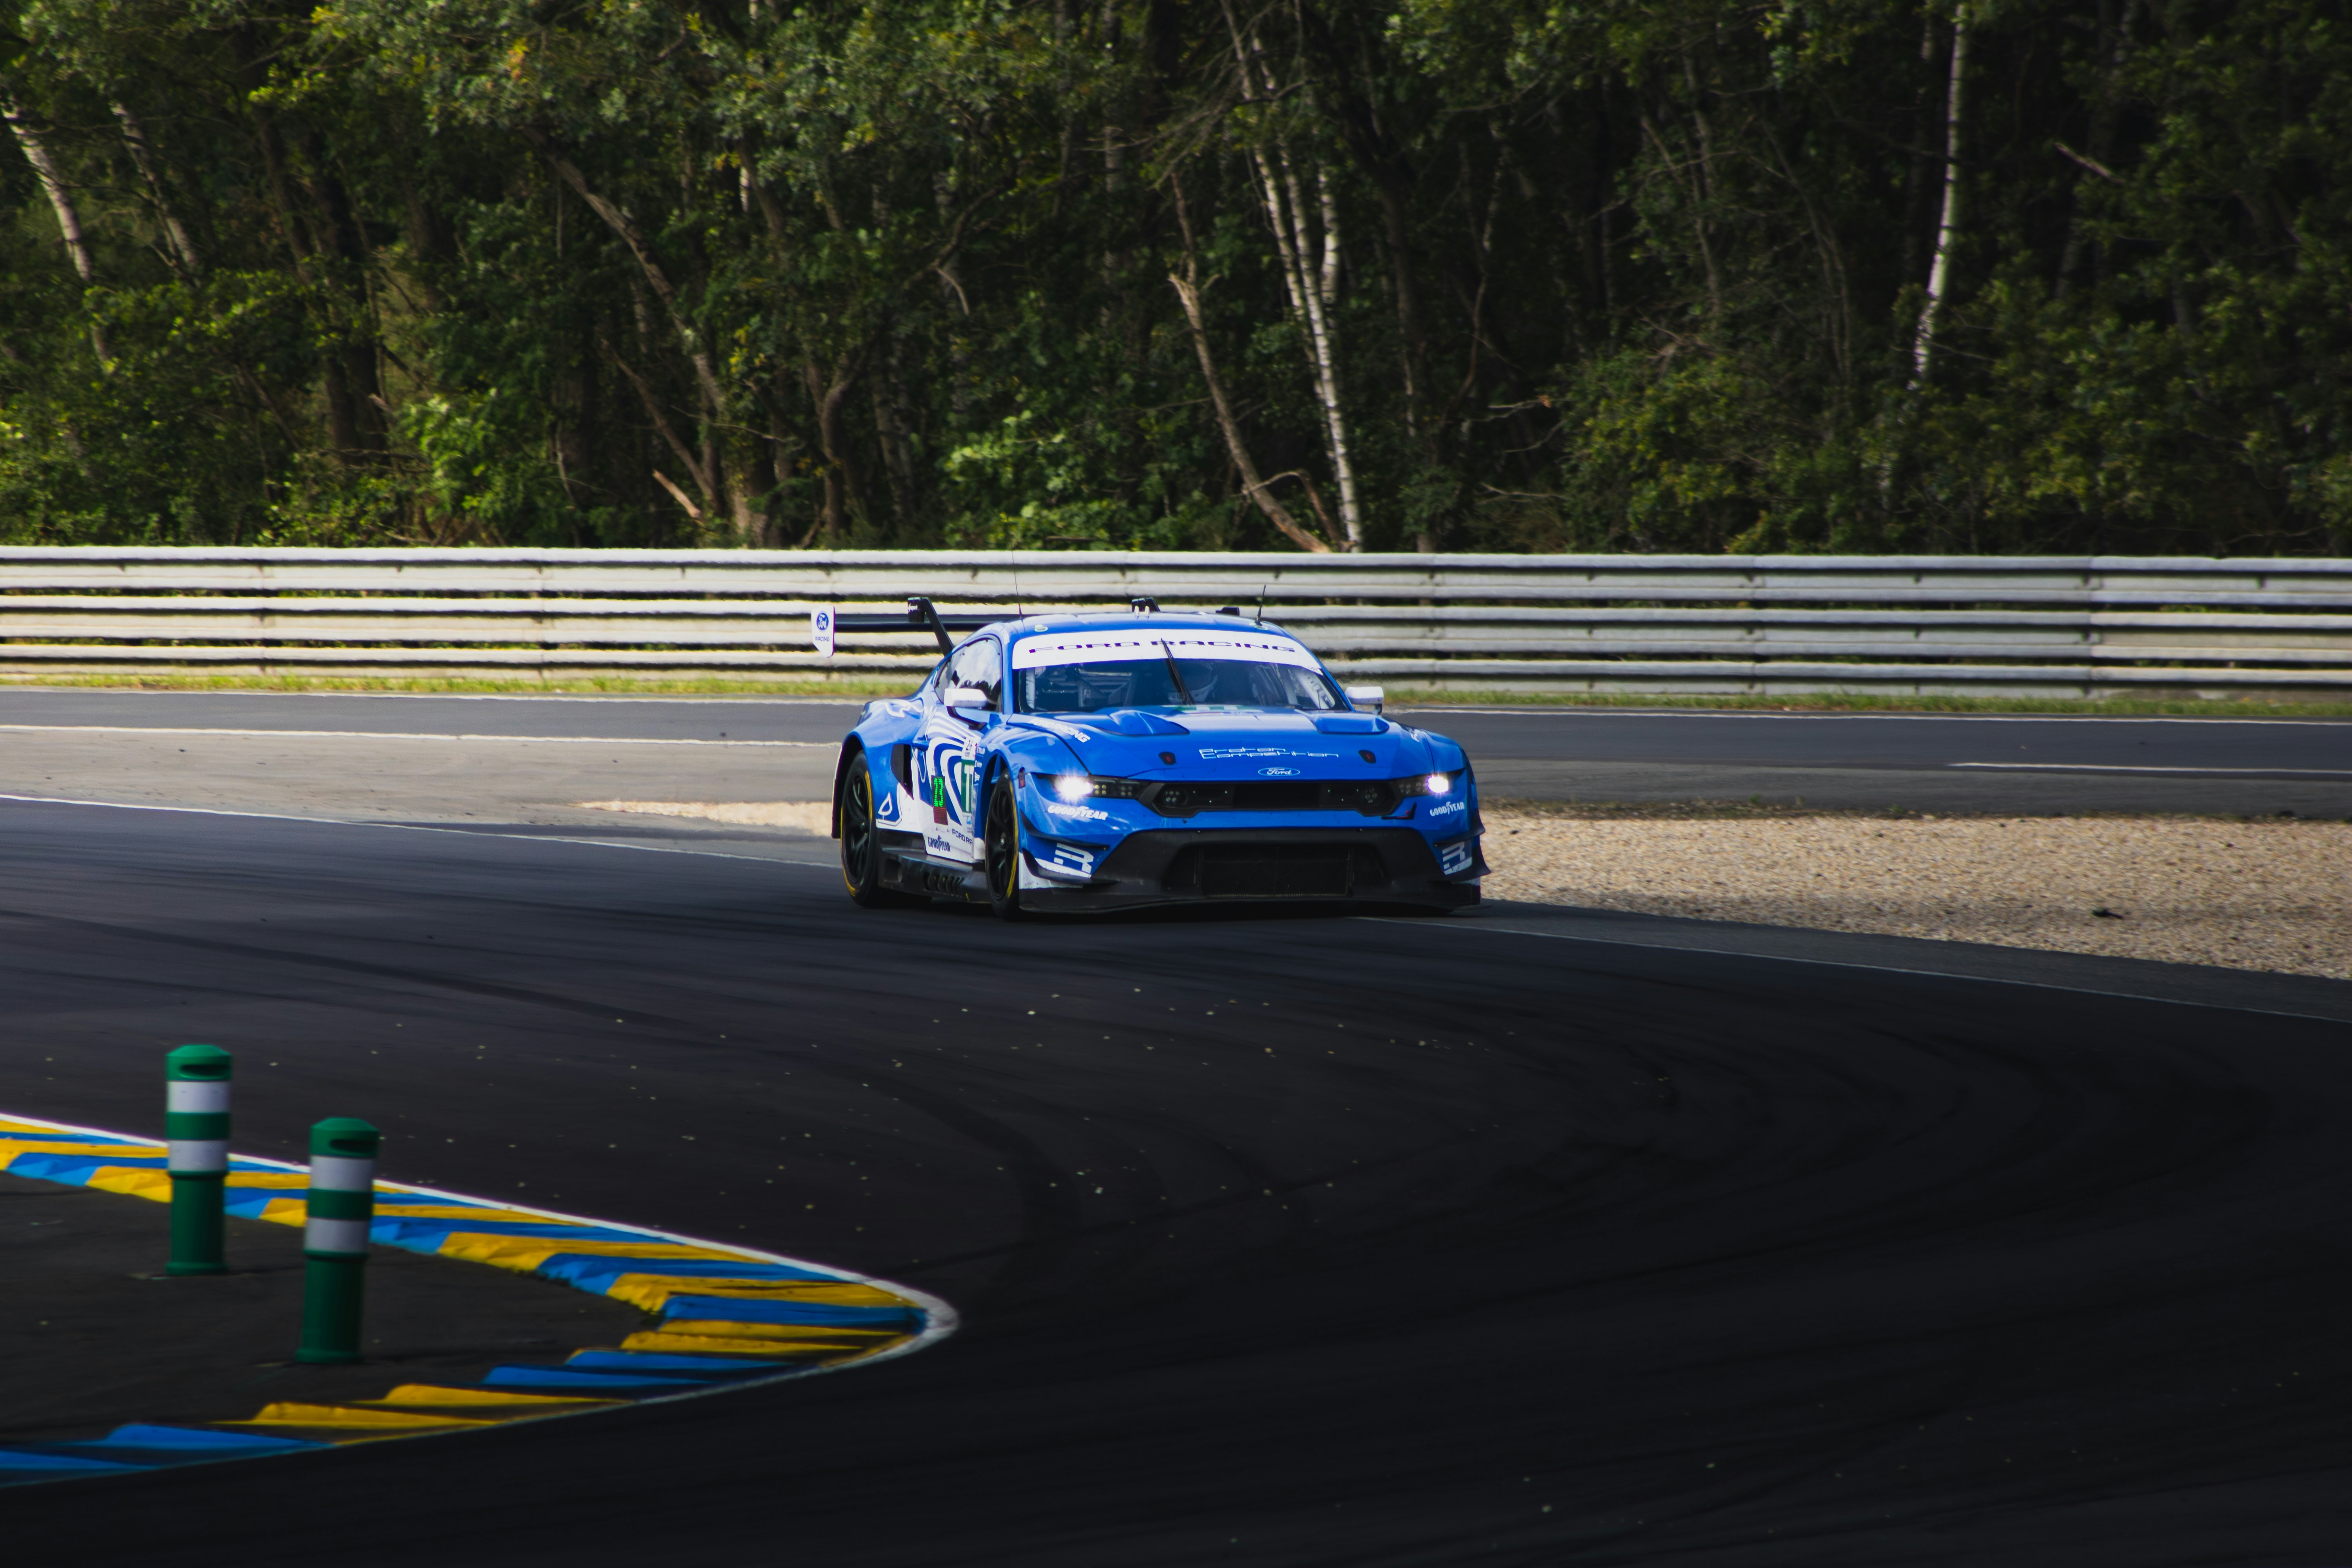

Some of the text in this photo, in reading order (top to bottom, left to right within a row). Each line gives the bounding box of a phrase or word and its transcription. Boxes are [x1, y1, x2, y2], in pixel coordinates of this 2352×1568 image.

[1029, 641, 1295, 653] FORD RACING
[1201, 751, 1339, 759] Competition
[1048, 805, 1108, 820] GOODYEAR
[1430, 801, 1465, 817] GOODYEAR
[952, 828, 965, 842] FORD
[927, 834, 951, 852] GOODYEAR
